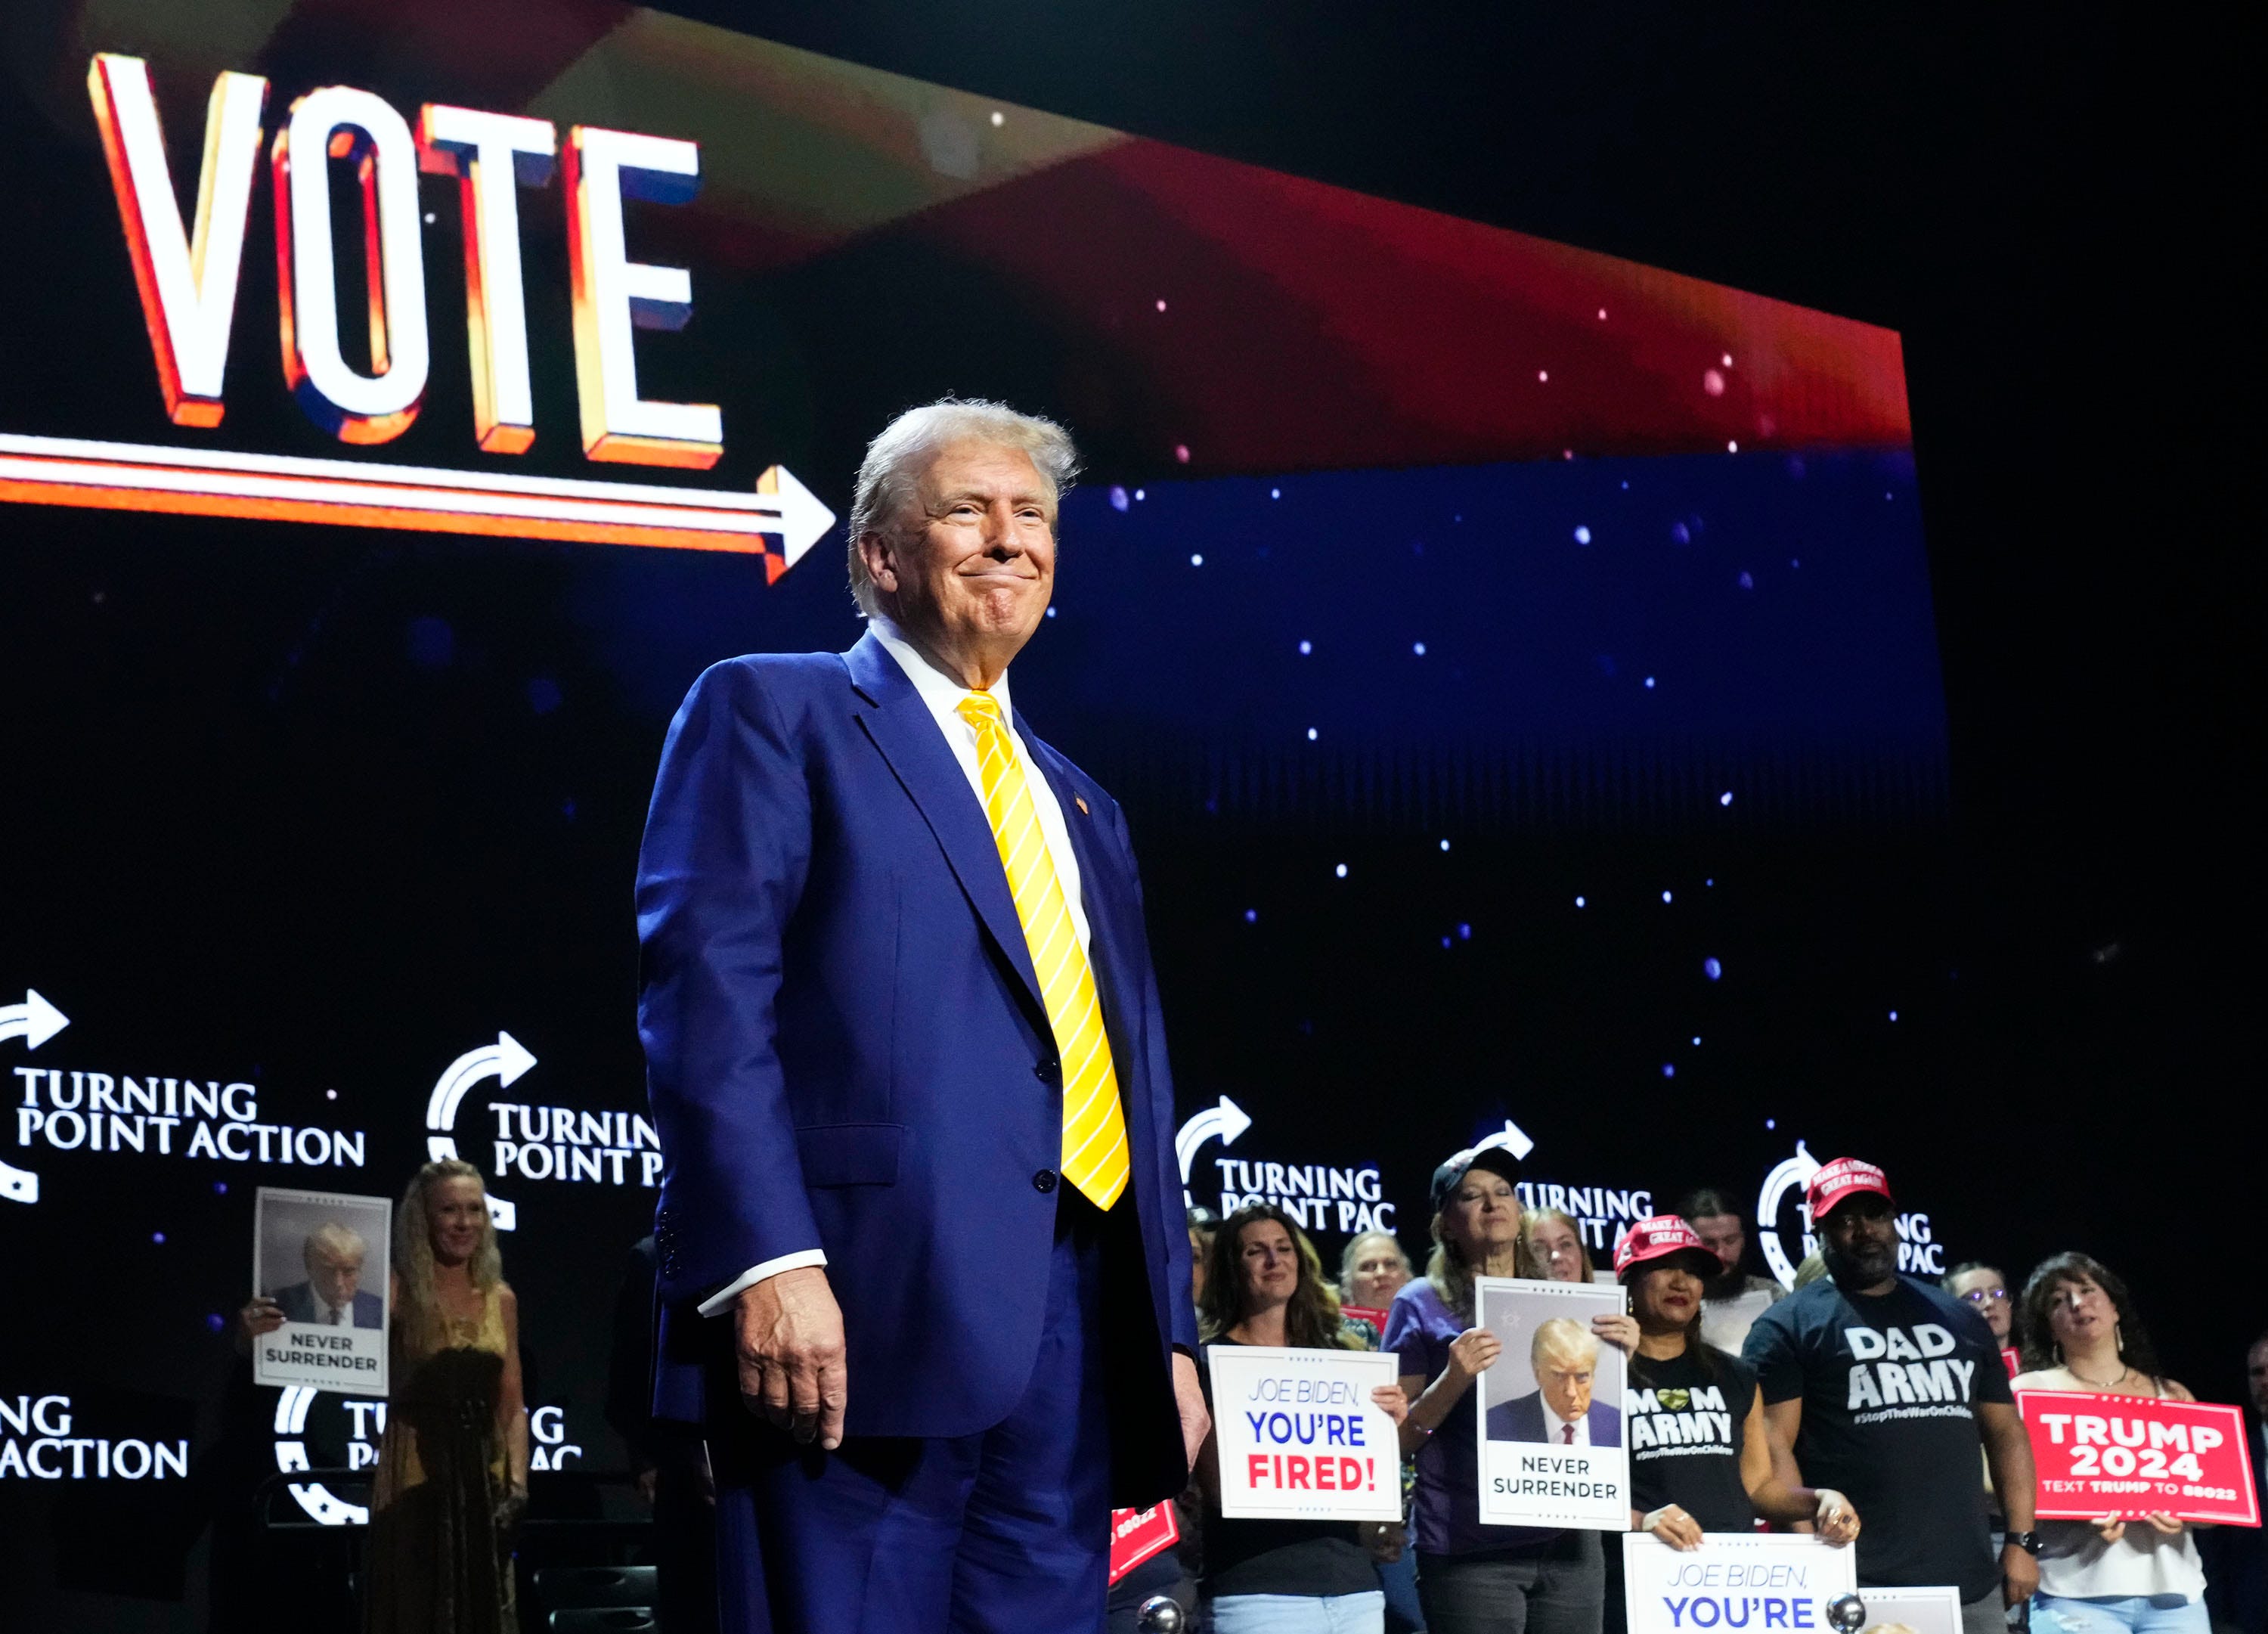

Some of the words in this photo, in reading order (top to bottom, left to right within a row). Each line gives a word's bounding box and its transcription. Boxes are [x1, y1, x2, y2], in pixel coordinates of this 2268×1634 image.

[88, 53, 723, 469] VOTE
[14, 1067, 256, 1121] TURNING
[17, 1108, 181, 1155] POINT
[187, 1121, 364, 1167] ACTION
[488, 1102, 661, 1150] TURNIN
[493, 1141, 632, 1185] POINT
[1215, 1158, 1382, 1202] TURNING
[1221, 1192, 1331, 1230] PNT
[1337, 1200, 1397, 1236] PAC
[1514, 1182, 1653, 1222] URNING
[1898, 1242, 1946, 1275] PAC
[266, 1348, 377, 1372] SURRENDER
[291, 1333, 352, 1350] NEVER
[1844, 1323, 1956, 1361] DAD
[1248, 1378, 1293, 1402] JOE
[1297, 1379, 1359, 1406] BIDEN,
[1847, 1359, 1975, 1410] ARMY
[1246, 1410, 1365, 1446] YOU'RE
[1631, 1411, 1732, 1450] ARMY
[2039, 1413, 2224, 1455] TRUMP
[0, 1438, 188, 1479] ACTION
[1248, 1454, 1374, 1491] FIRED!
[1522, 1456, 1589, 1474] NEVER
[2069, 1444, 2204, 1482] 2024
[1494, 1477, 1616, 1499] SURRENDER
[2043, 1480, 2086, 1493] TEXT
[2090, 1481, 2152, 1494] TRUMP
[2155, 1482, 2179, 1496] TO
[1667, 1564, 1722, 1586] JOE
[1726, 1564, 1808, 1589] BIDEN,
[1662, 1596, 1814, 1628] YOU'RE
